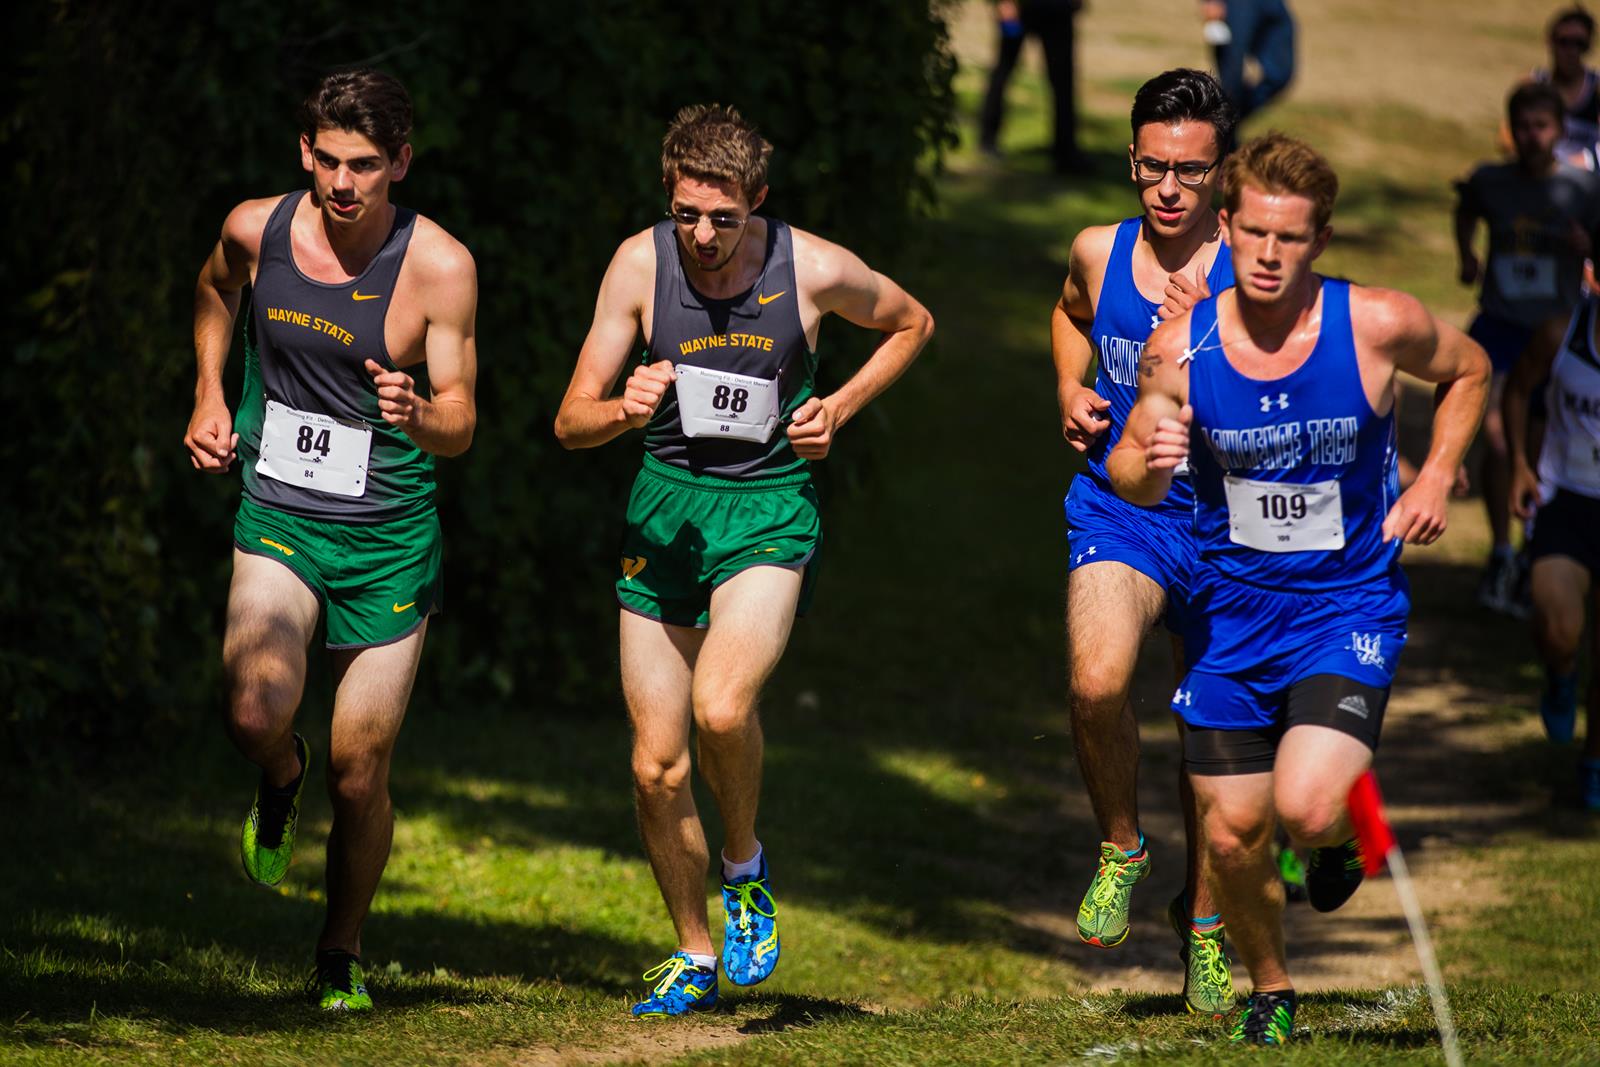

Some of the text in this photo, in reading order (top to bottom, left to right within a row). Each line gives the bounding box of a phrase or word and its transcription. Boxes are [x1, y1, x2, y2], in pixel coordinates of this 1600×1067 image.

[267, 307, 355, 346] WAYNE STATE
[680, 333, 774, 355] WAYNE STATE
[1101, 335, 1146, 388] LAWR
[712, 385, 749, 413] 88
[297, 425, 331, 457] 84
[720, 424, 730, 432] 88
[1306, 416, 1359, 466] TECH
[304, 470, 314, 479] 84
[1256, 494, 1307, 520] 109
